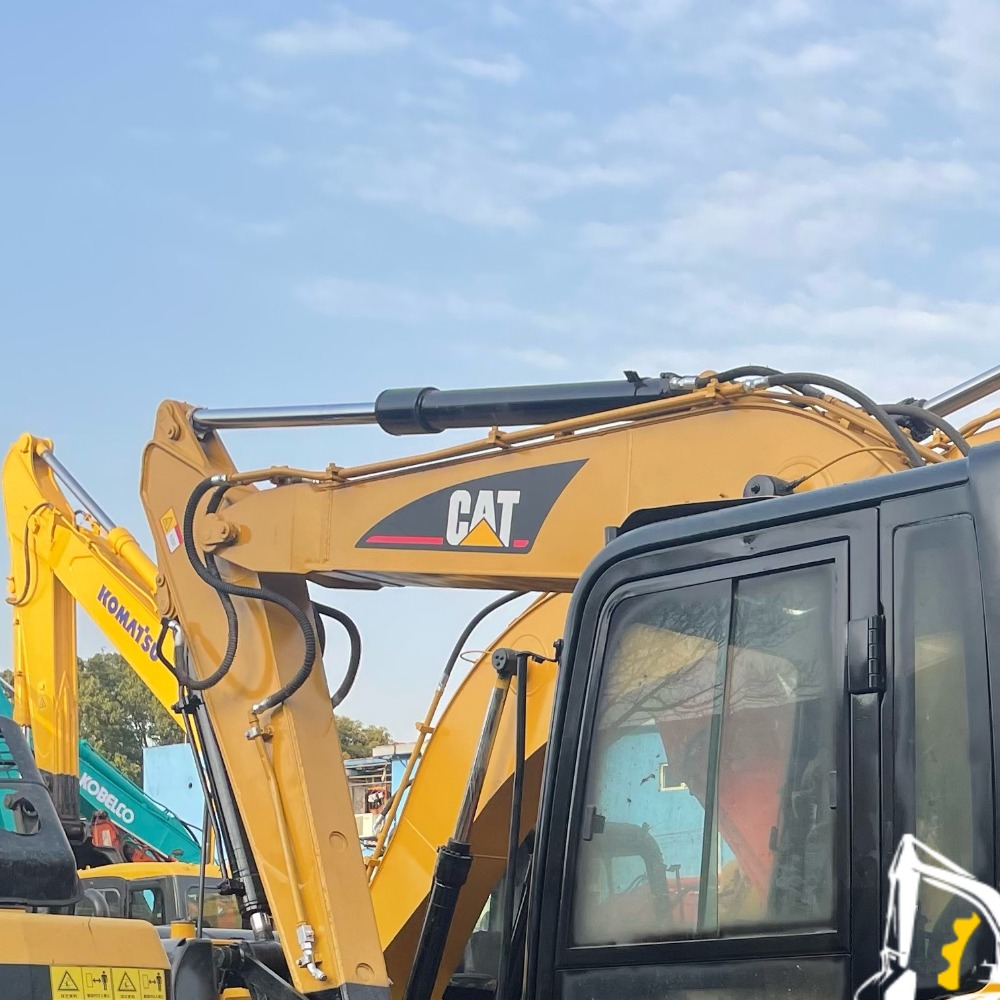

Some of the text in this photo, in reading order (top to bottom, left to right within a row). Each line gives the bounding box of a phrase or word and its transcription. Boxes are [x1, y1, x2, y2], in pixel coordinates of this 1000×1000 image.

[446, 490, 521, 547] CAT
[97, 584, 159, 661] KOMATSU
[79, 772, 135, 824] KOBELCO
